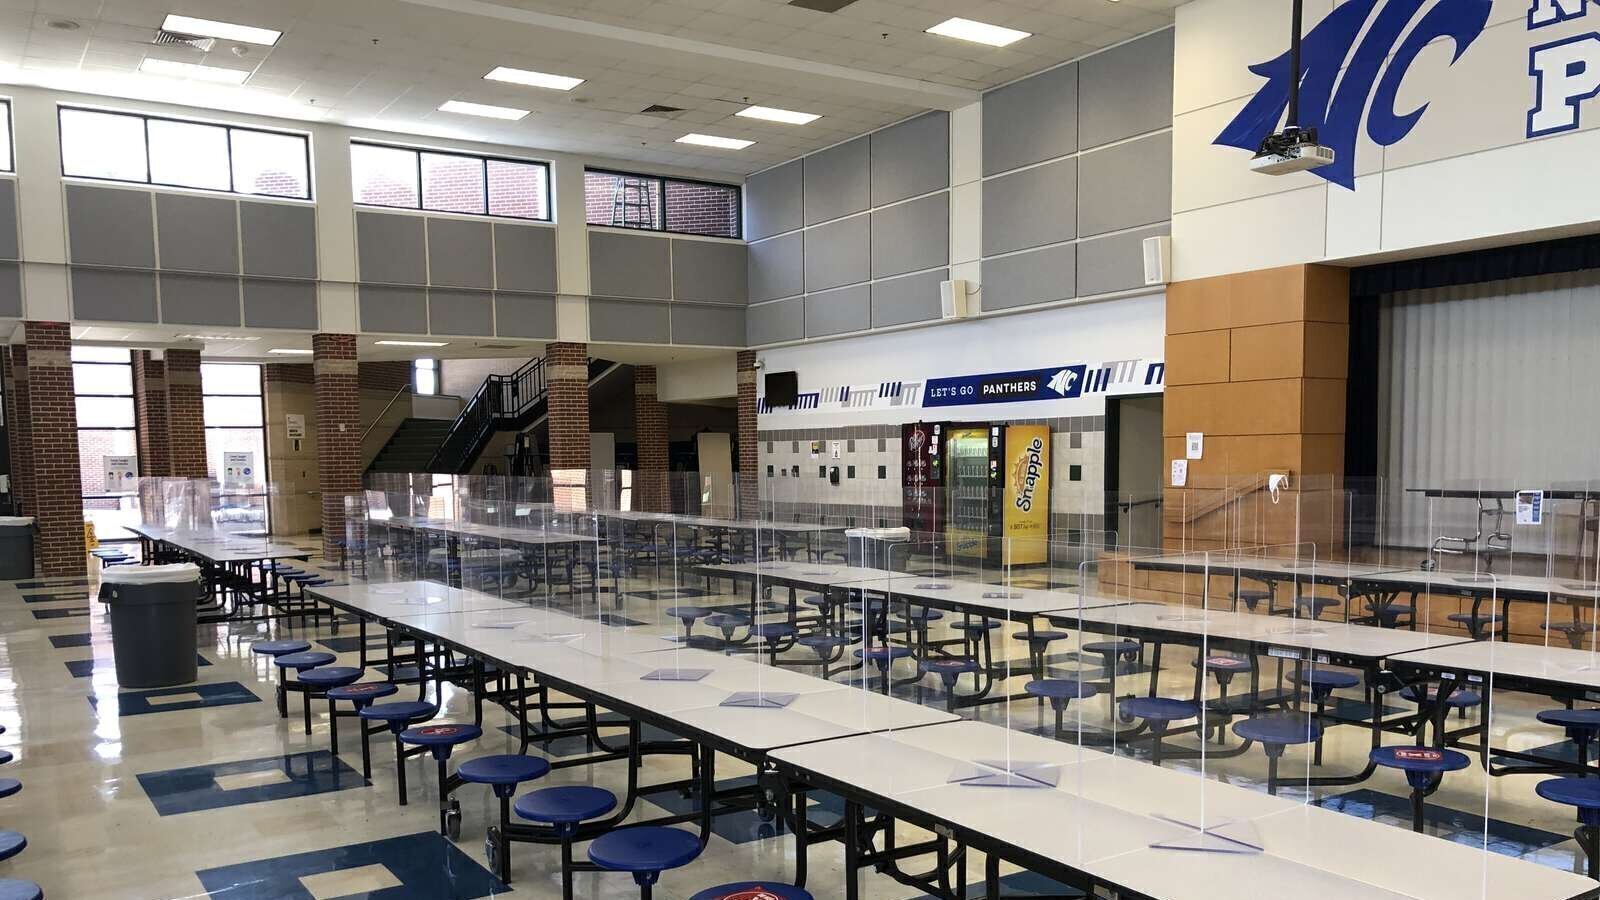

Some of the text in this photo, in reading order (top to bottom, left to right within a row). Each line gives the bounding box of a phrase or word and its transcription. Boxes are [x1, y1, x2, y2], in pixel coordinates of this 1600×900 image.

[931, 380, 1037, 398] LET'S GO PANTHERS
[1015, 437, 1043, 513] Snapple
